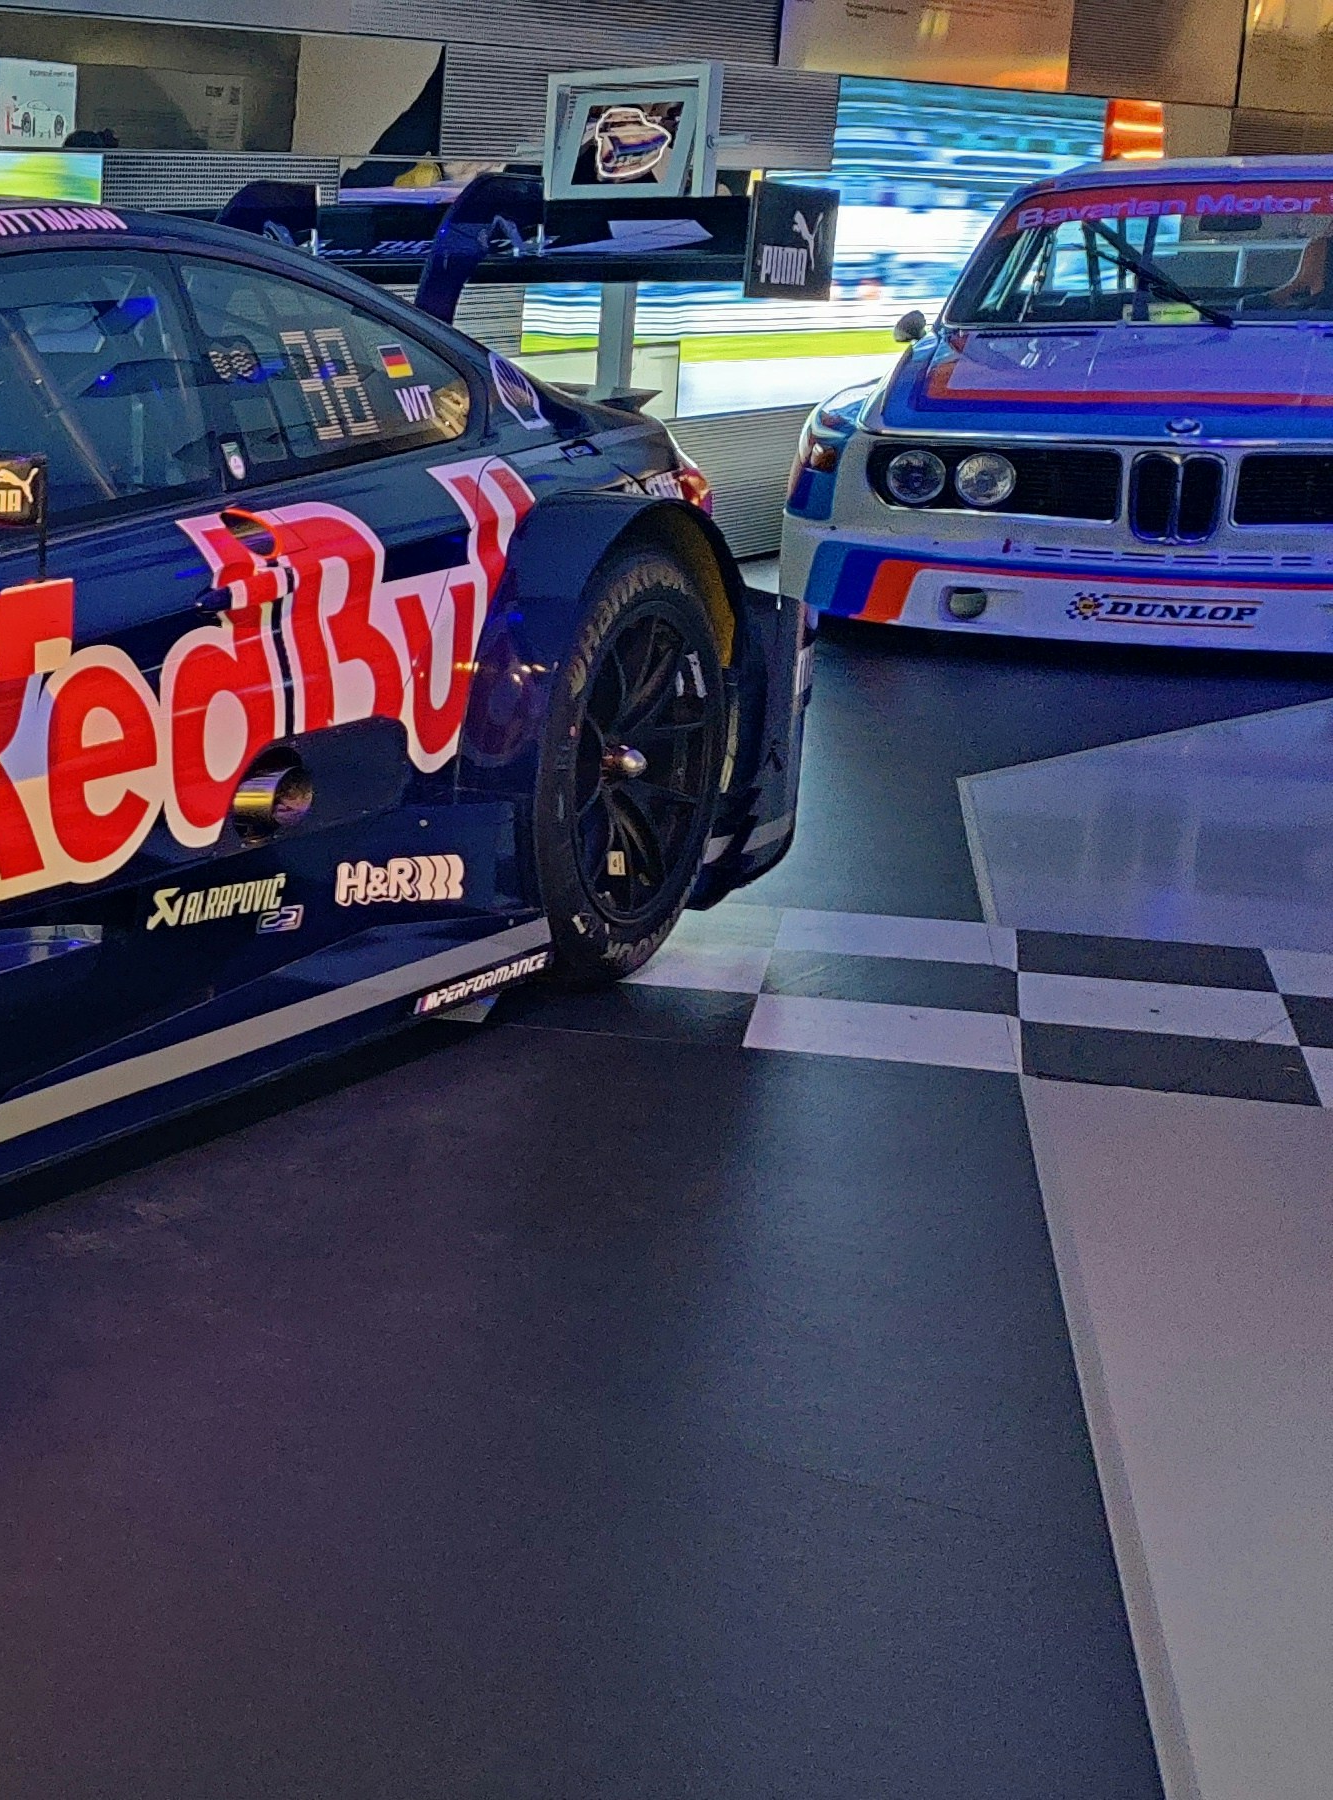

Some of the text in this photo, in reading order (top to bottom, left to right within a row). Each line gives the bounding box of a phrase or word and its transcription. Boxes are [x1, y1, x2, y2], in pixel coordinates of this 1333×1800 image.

[1016, 194, 1322, 230] Bavarian Motor
[760, 245, 808, 286] PUMA
[395, 384, 436, 422] WIT
[1105, 601, 1258, 621] DUNLOP
[335, 857, 419, 906] H&R
